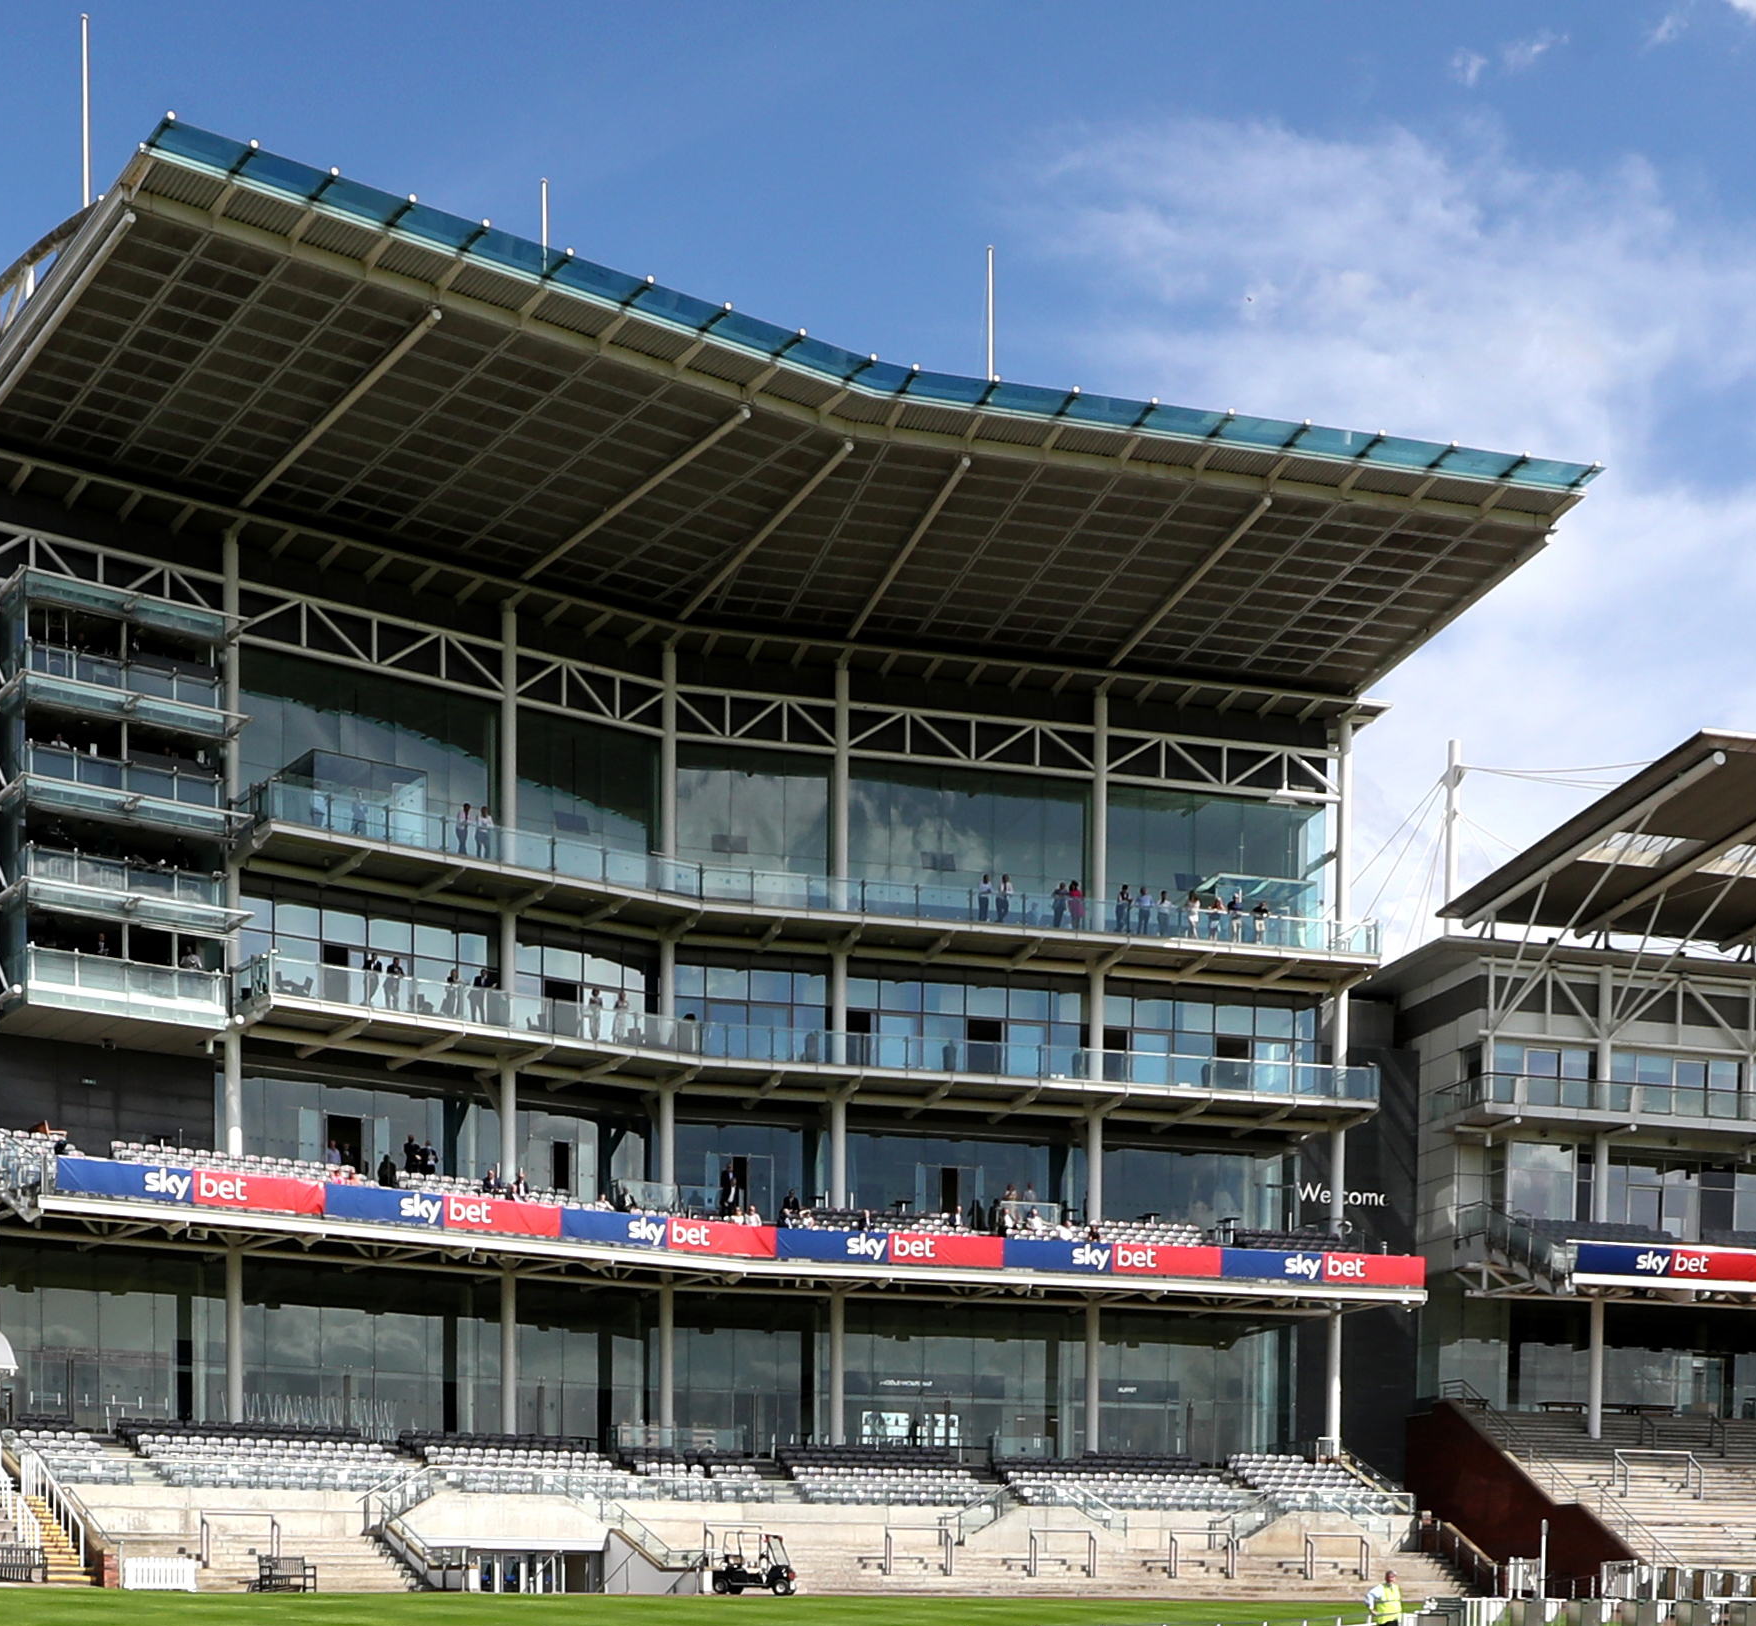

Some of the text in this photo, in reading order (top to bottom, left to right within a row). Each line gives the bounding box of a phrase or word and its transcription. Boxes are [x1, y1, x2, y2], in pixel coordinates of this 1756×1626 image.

[144, 1168, 247, 1201] sky bet
[1297, 1182, 1391, 1207] Wecome
[401, 1189, 491, 1224] sky bet
[629, 1217, 709, 1247] sky bet
[846, 1232, 936, 1261] sky bet
[1072, 1243, 1157, 1271] sky bet
[1284, 1252, 1366, 1280] sky bet
[1635, 1250, 1710, 1275] sky bet
